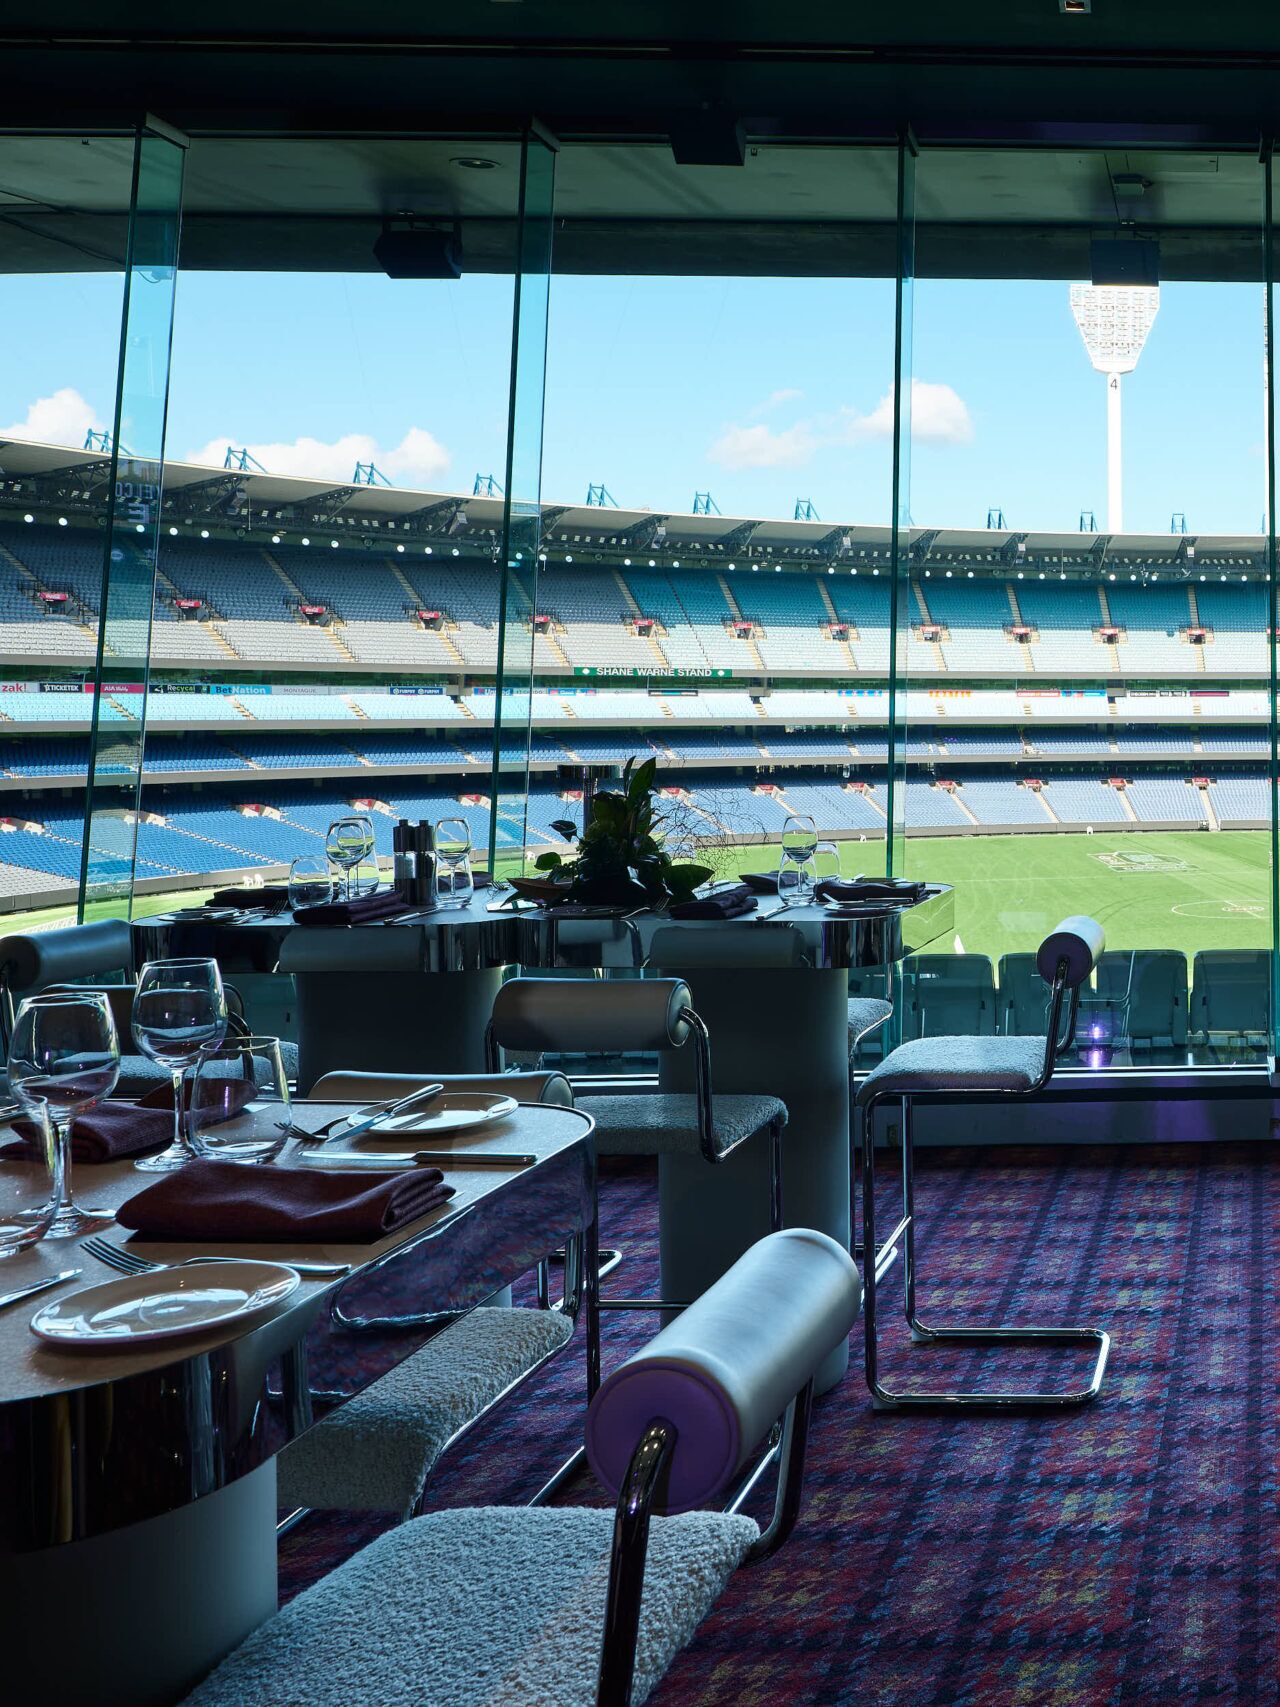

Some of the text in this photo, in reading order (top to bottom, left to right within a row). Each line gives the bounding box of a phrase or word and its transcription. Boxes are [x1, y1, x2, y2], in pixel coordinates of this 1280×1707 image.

[1109, 377, 1118, 390] 4
[596, 667, 712, 677] SHANE WARNE STAND
[215, 684, 266, 694] BetNation
